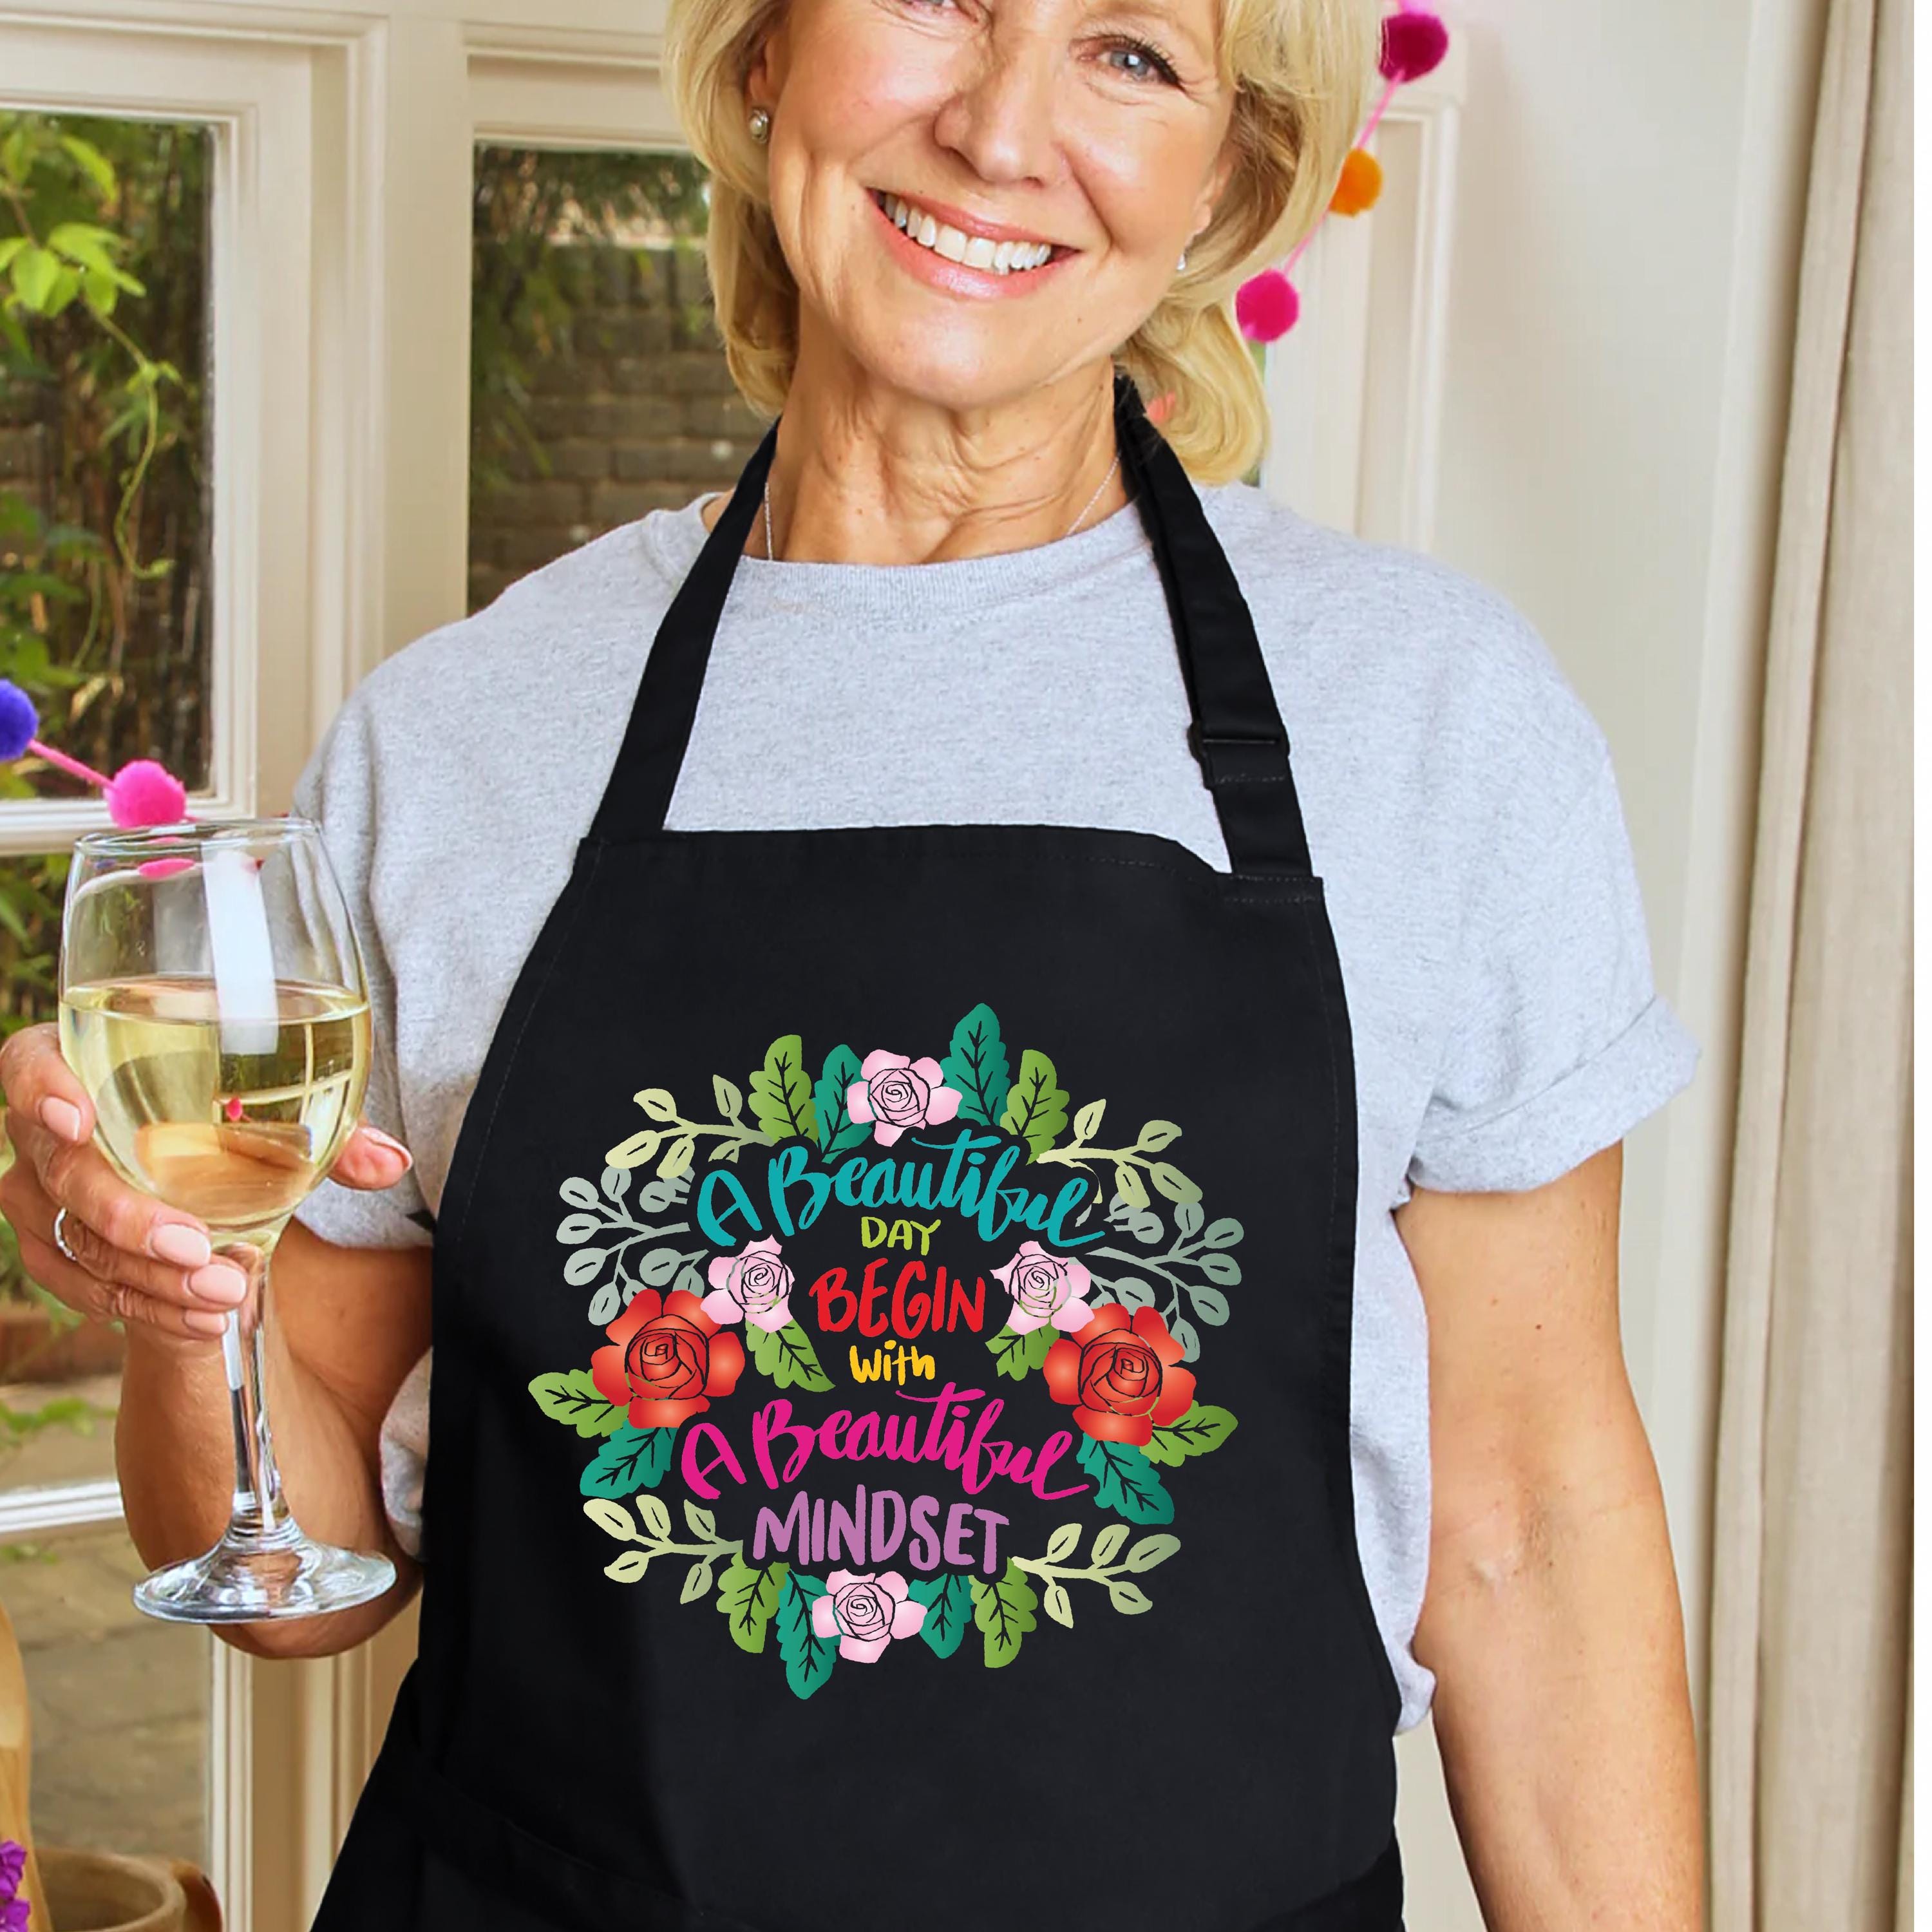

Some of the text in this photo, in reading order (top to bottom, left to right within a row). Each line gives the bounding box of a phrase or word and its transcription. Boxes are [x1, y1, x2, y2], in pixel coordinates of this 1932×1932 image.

[697, 1130, 1105, 1246] A Beautiful
[860, 1217, 942, 1255] DAY
[809, 1258, 985, 1339] BEGIN
[681, 1382, 1090, 1499] A Beautiful
[753, 1484, 1010, 1574] MINDSET
